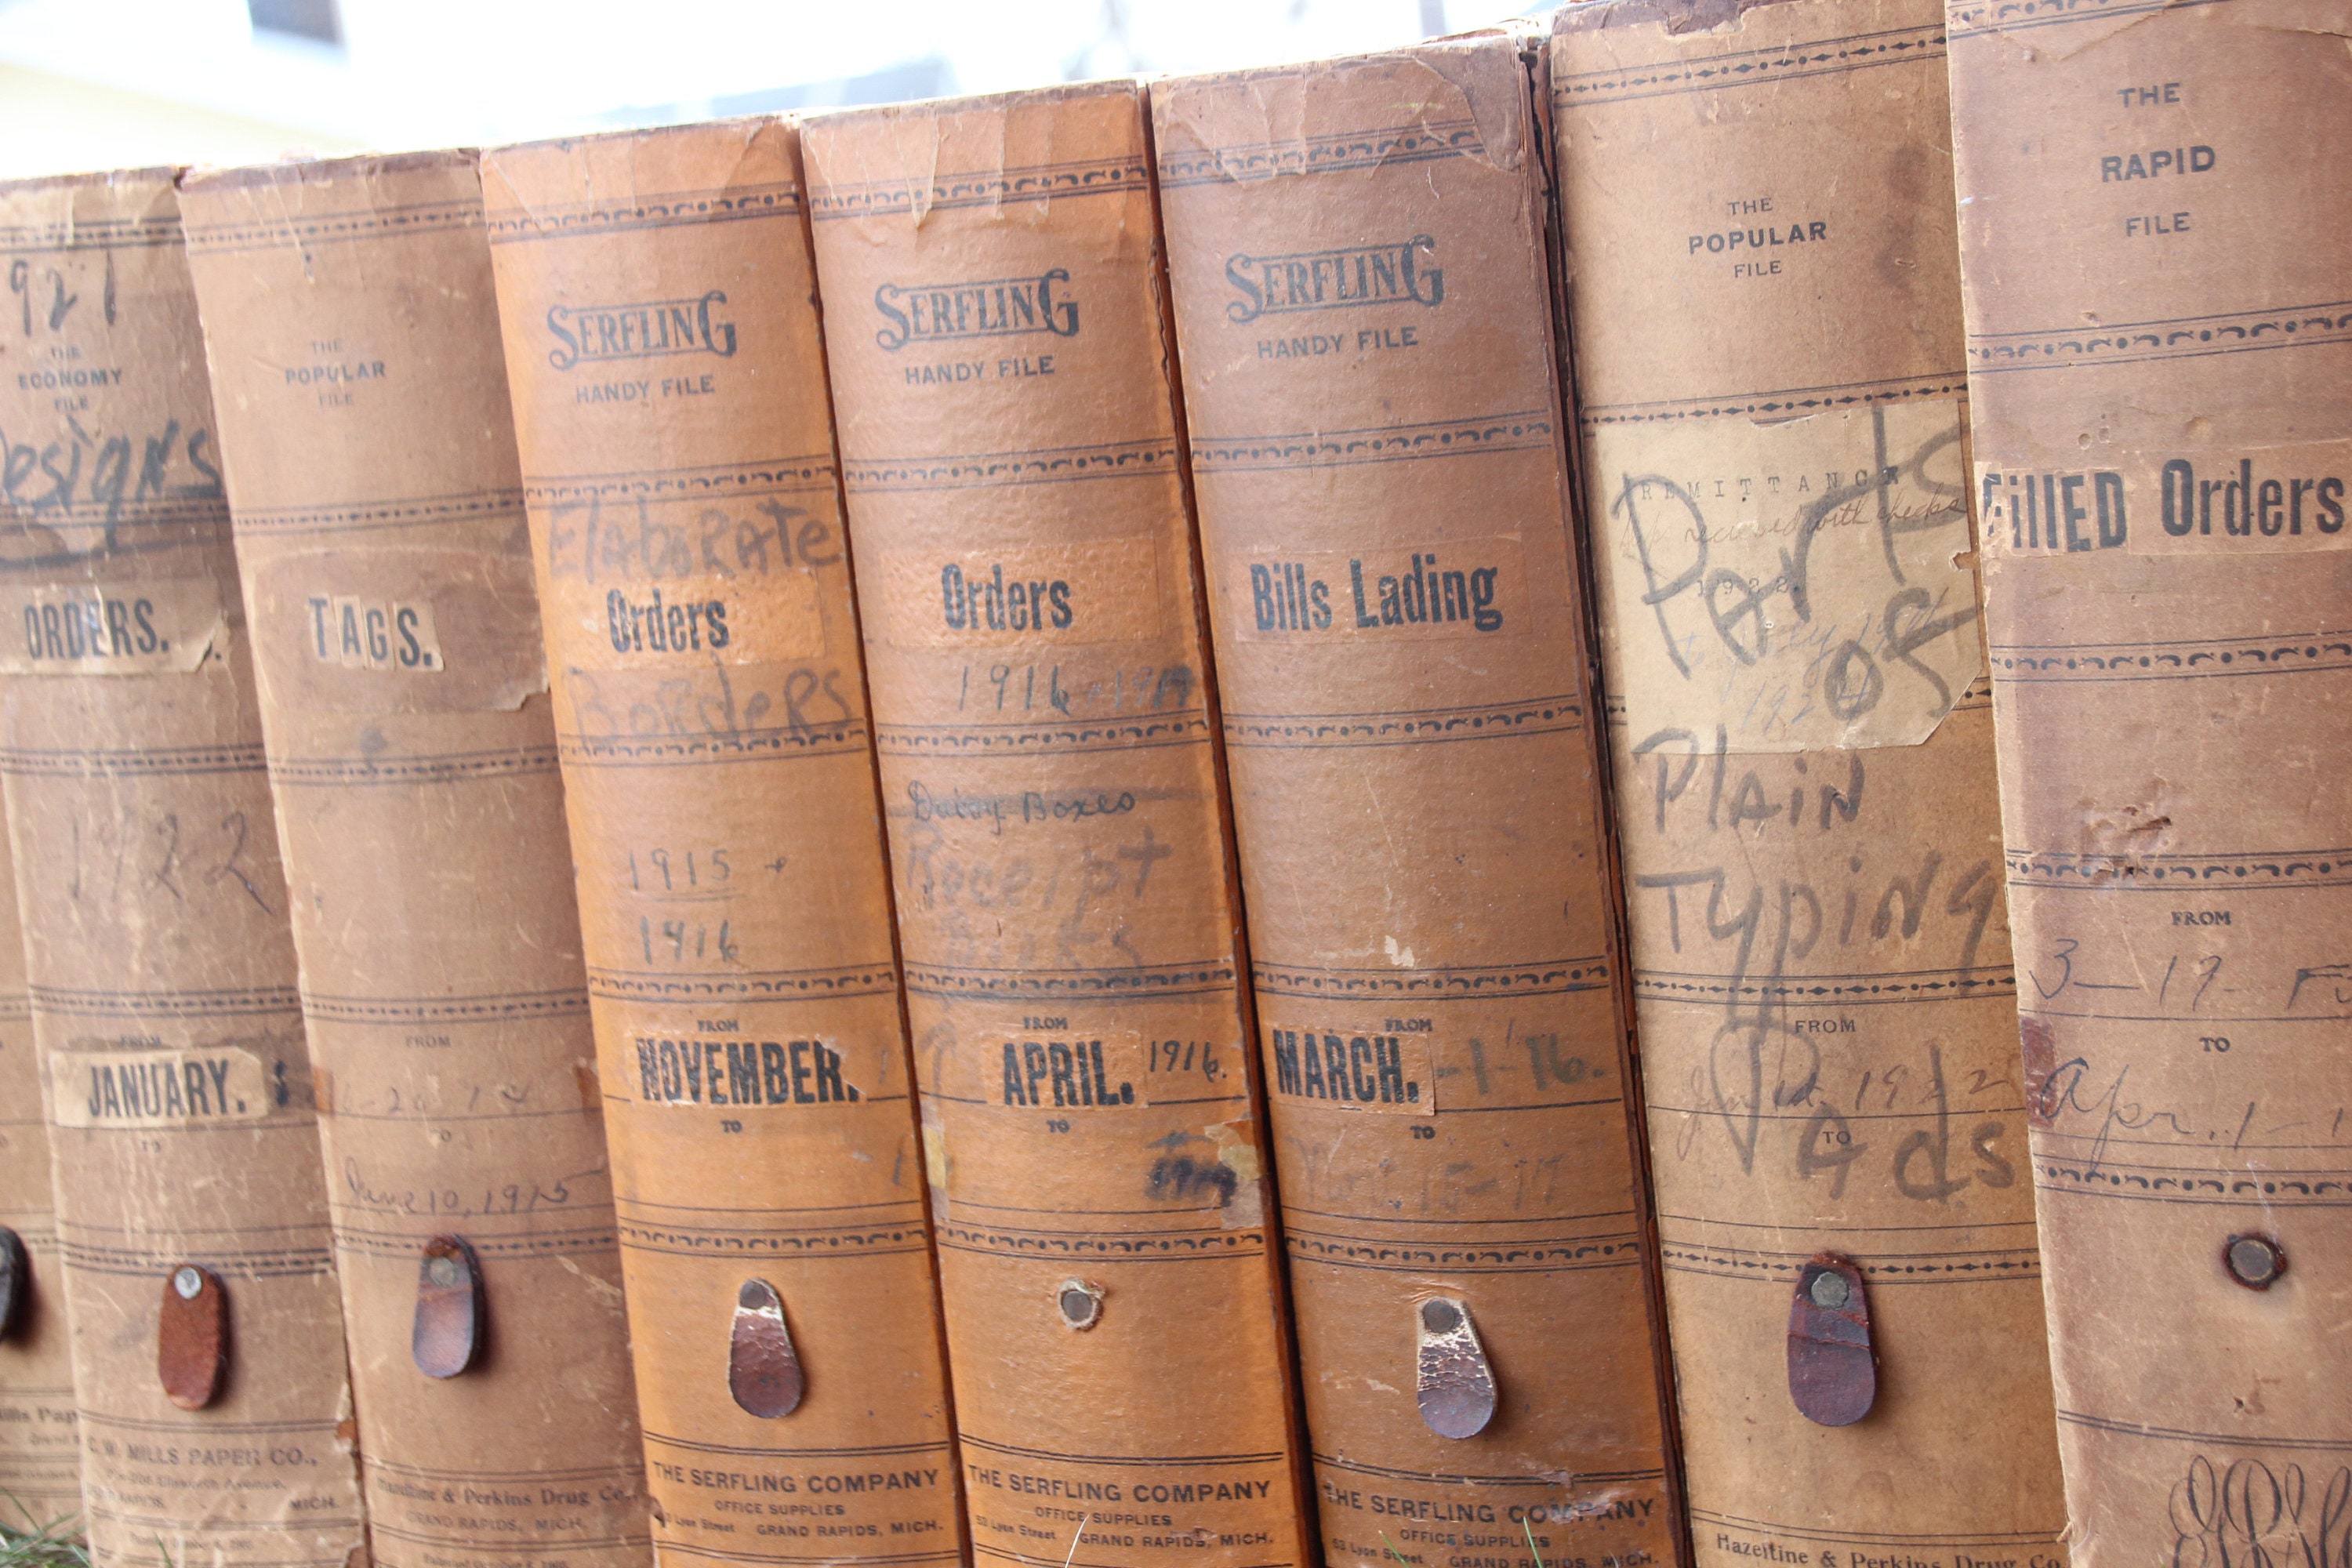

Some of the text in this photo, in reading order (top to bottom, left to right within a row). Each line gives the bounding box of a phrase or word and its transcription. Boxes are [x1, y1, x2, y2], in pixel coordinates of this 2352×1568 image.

[2117, 82, 2182, 108] THE
[2102, 145, 2216, 182] RAPID
[1728, 197, 1773, 216] THE
[2125, 211, 2190, 236] FILE
[1689, 221, 1828, 255] POPULAR
[1225, 234, 1445, 324] SERFLING
[1733, 260, 1783, 278] FILE
[874, 267, 1080, 352] SERFLING
[546, 289, 738, 371] SERFLING
[310, 339, 343, 353] THE
[1257, 326, 1420, 360] HANDY FILE
[17, 368, 124, 391] ECONOMY
[285, 361, 387, 384] POPULAR
[905, 354, 1056, 386] HANDY FILE
[318, 394, 354, 407] FILE
[575, 374, 717, 405] HANDY FILE
[53, 395, 89, 412] FILE
[2161, 459, 2345, 537] Orders
[941, 562, 1073, 631] Orders
[1250, 552, 1504, 633] Bills Lading
[24, 600, 171, 660] ORDERS.
[309, 598, 433, 666] TAGS.
[607, 587, 731, 654] Orders
[629, 848, 731, 891] 1915
[2171, 910, 2231, 926] FROM
[697, 1020, 739, 1033] FROM
[1023, 1016, 1068, 1031] FROM
[1385, 1018, 1433, 1033] FROM
[1795, 1019, 1856, 1034] FROM
[405, 1036, 451, 1048] FROM
[2198, 1036, 2231, 1052] TO
[636, 1037, 859, 1105] NOVEMBER.
[1003, 1040, 1134, 1106] APRIL.
[1272, 1029, 1420, 1104] MARCH.
[89, 1059, 248, 1119] JANUARY.
[720, 1120, 743, 1134] TO
[1046, 1119, 1069, 1134] TO
[1410, 1124, 1436, 1140] TO
[1822, 1131, 1852, 1145] TO
[127, 1443, 180, 1465] MILLS
[188, 1449, 263, 1467] PAPER
[654, 1461, 939, 1494] THE SERFLING COMPANY
[968, 1464, 1272, 1504] THE SERFLING COMPANY
[443, 1489, 456, 1504] &
[463, 1490, 532, 1506] Perkins
[541, 1489, 590, 1506] Drug
[715, 1500, 846, 1517] OFFICE SUPPLIES
[1370, 1494, 1496, 1523] SERFLING
[405, 1510, 454, 1529] GRAND
[535, 1518, 586, 1530] MICH.
[1034, 1506, 1172, 1526] OFFICE SUPPLIES
[757, 1520, 945, 1538] GRAND RAPIDS, MICH.
[990, 1519, 1015, 1534] Lyon
[1019, 1524, 1056, 1540] Street
[1080, 1531, 1274, 1549] GRAND RAPIDS, MICH.
[1399, 1529, 1551, 1549] OFFICE SUPPLIES
[1332, 1537, 1346, 1552] 53
[1350, 1543, 1377, 1558] Lyon
[1717, 1533, 1809, 1565] Hazeltine
[1820, 1550, 1837, 1568] &
[1850, 1551, 1941, 1568] Perkins
[1449, 1555, 1510, 1568] GRAND
